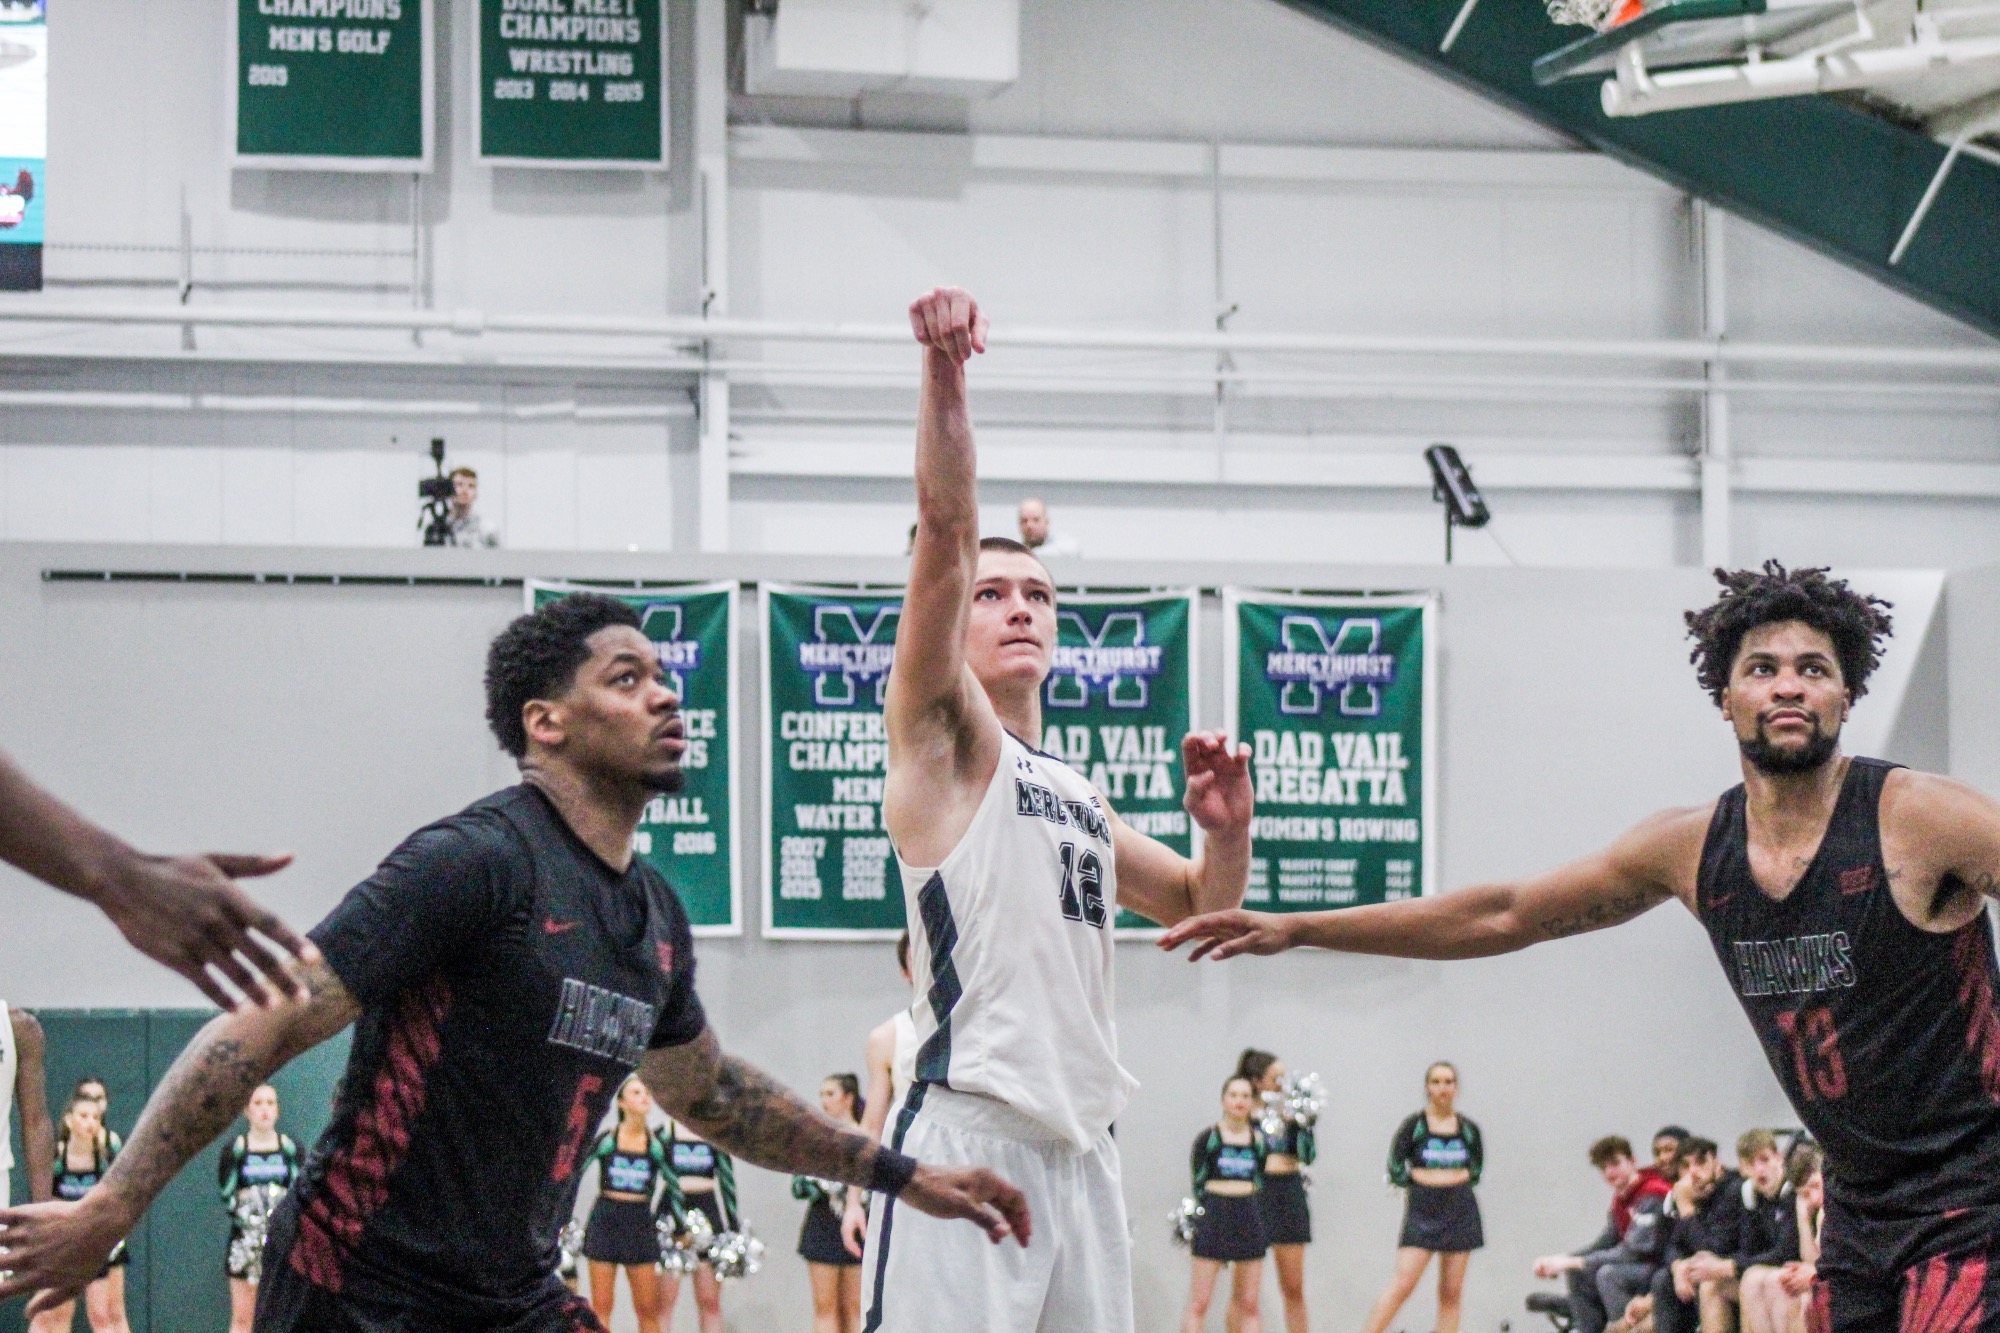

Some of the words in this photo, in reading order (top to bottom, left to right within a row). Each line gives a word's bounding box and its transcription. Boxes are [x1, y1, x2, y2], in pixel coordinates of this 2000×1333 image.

[259, 0, 401, 20] CHAMPIONS
[337, 28, 391, 55] GOLF
[500, 13, 641, 43] CHAMPIONS
[509, 48, 633, 76] WRESTLING
[549, 80, 589, 101] 2014
[1051, 646, 1162, 669] ERCYHURST
[1267, 652, 1393, 676] MERCYHURST
[781, 711, 888, 741] CONFER
[789, 740, 890, 771] CHAMPI
[1041, 725, 1091, 761] AD
[1099, 725, 1175, 763] VAIL
[1254, 730, 1323, 768] DAD
[1331, 732, 1409, 770] VAIL
[832, 776, 883, 803] MEN
[1089, 762, 1174, 799] ATTA
[1256, 767, 1407, 806] REGATTA
[794, 803, 876, 831] WATER
[1339, 817, 1419, 844] ROWING
[1058, 841, 1107, 930] 12
[1733, 931, 1857, 996] HAWKS
[1775, 1007, 1849, 1101] 13
